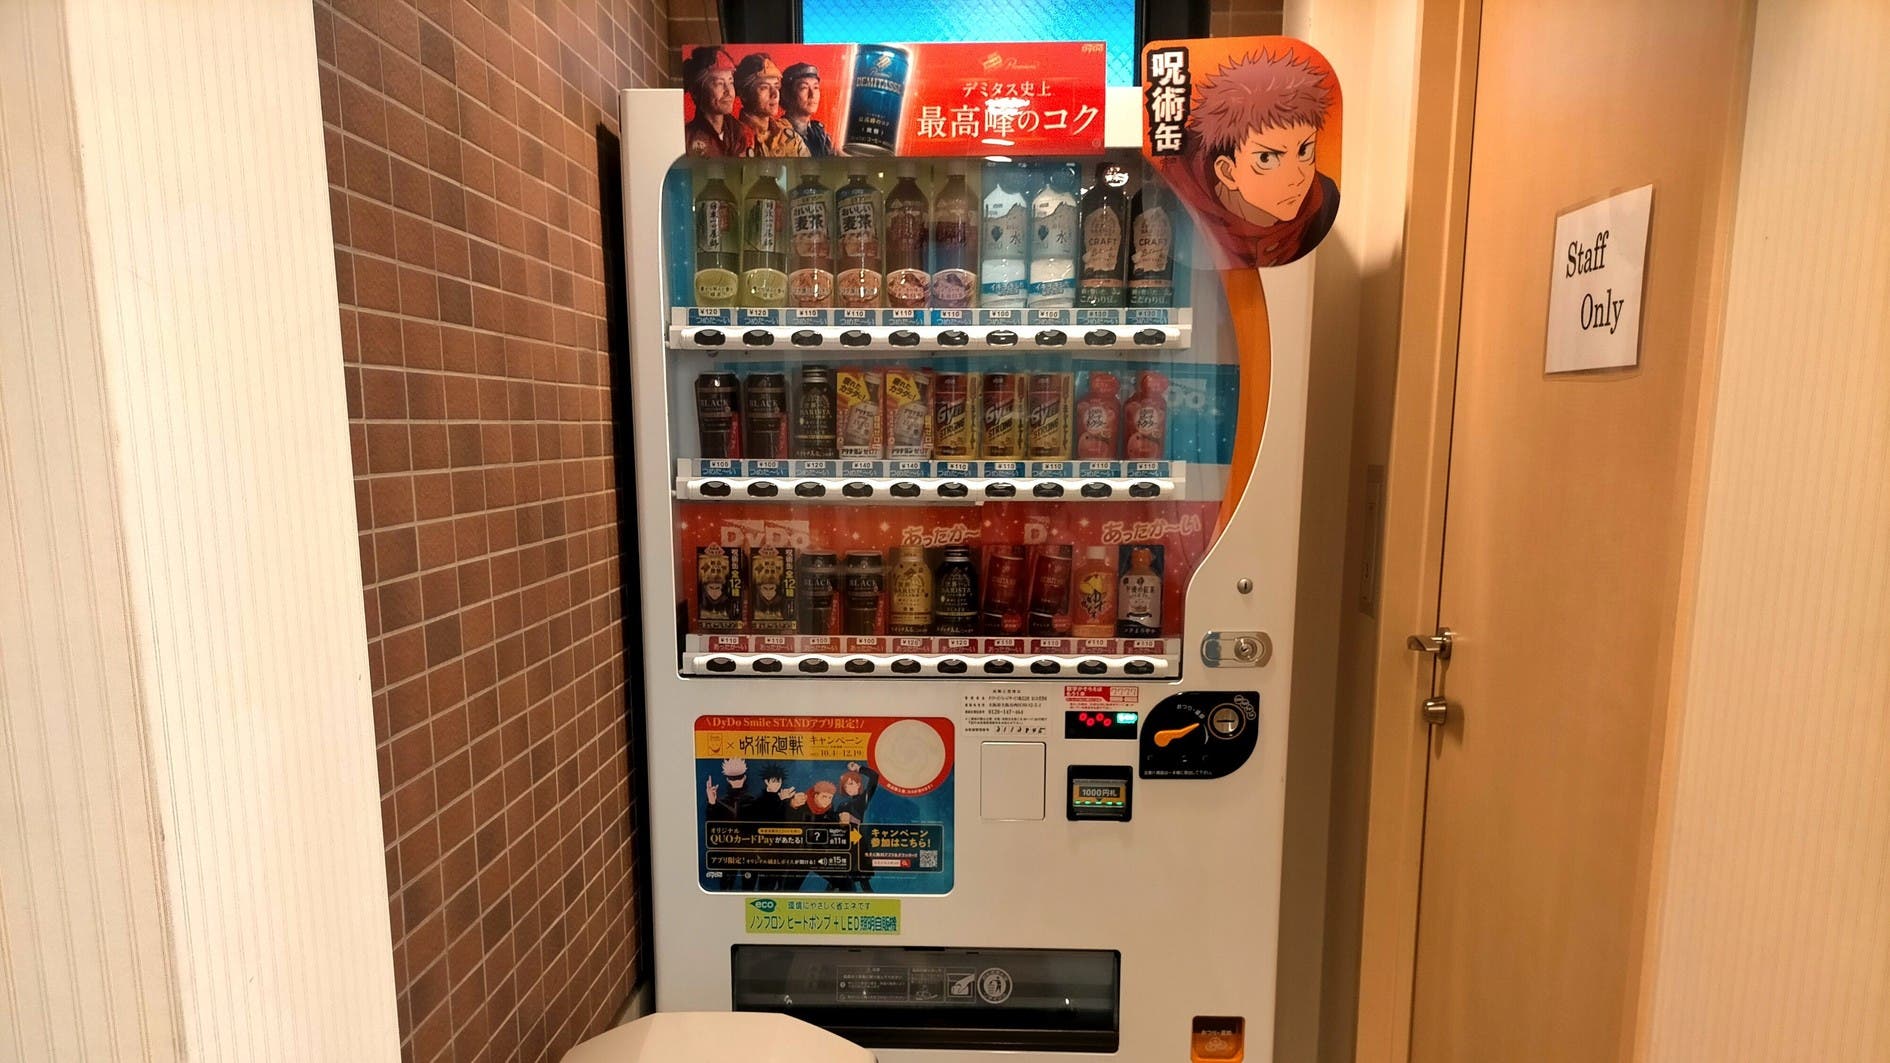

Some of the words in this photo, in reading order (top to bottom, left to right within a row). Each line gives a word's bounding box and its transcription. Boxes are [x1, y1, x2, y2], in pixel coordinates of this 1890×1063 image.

[963, 81, 1052, 97] デミタス史上
[1151, 50, 1187, 152] 呪術缶
[917, 104, 1099, 138] 最高峰のコク
[795, 215, 824, 231] 麦茶
[841, 216, 872, 231] 麦茶
[1088, 238, 1117, 247] CRAFT
[1565, 230, 1609, 278] Staff
[1580, 288, 1624, 335] Only
[712, 718, 742, 729] DyDo
[743, 717, 771, 727] Smile
[739, 735, 804, 756] 呪術廻戦
[809, 736, 863, 745] キャンペーン
[1082, 788, 1118, 797] 1000円札
[871, 828, 928, 837] キャンペーン
[871, 837, 931, 848] 参加はこちら!
[788, 901, 871, 910] 環境にやさしく省エネです
